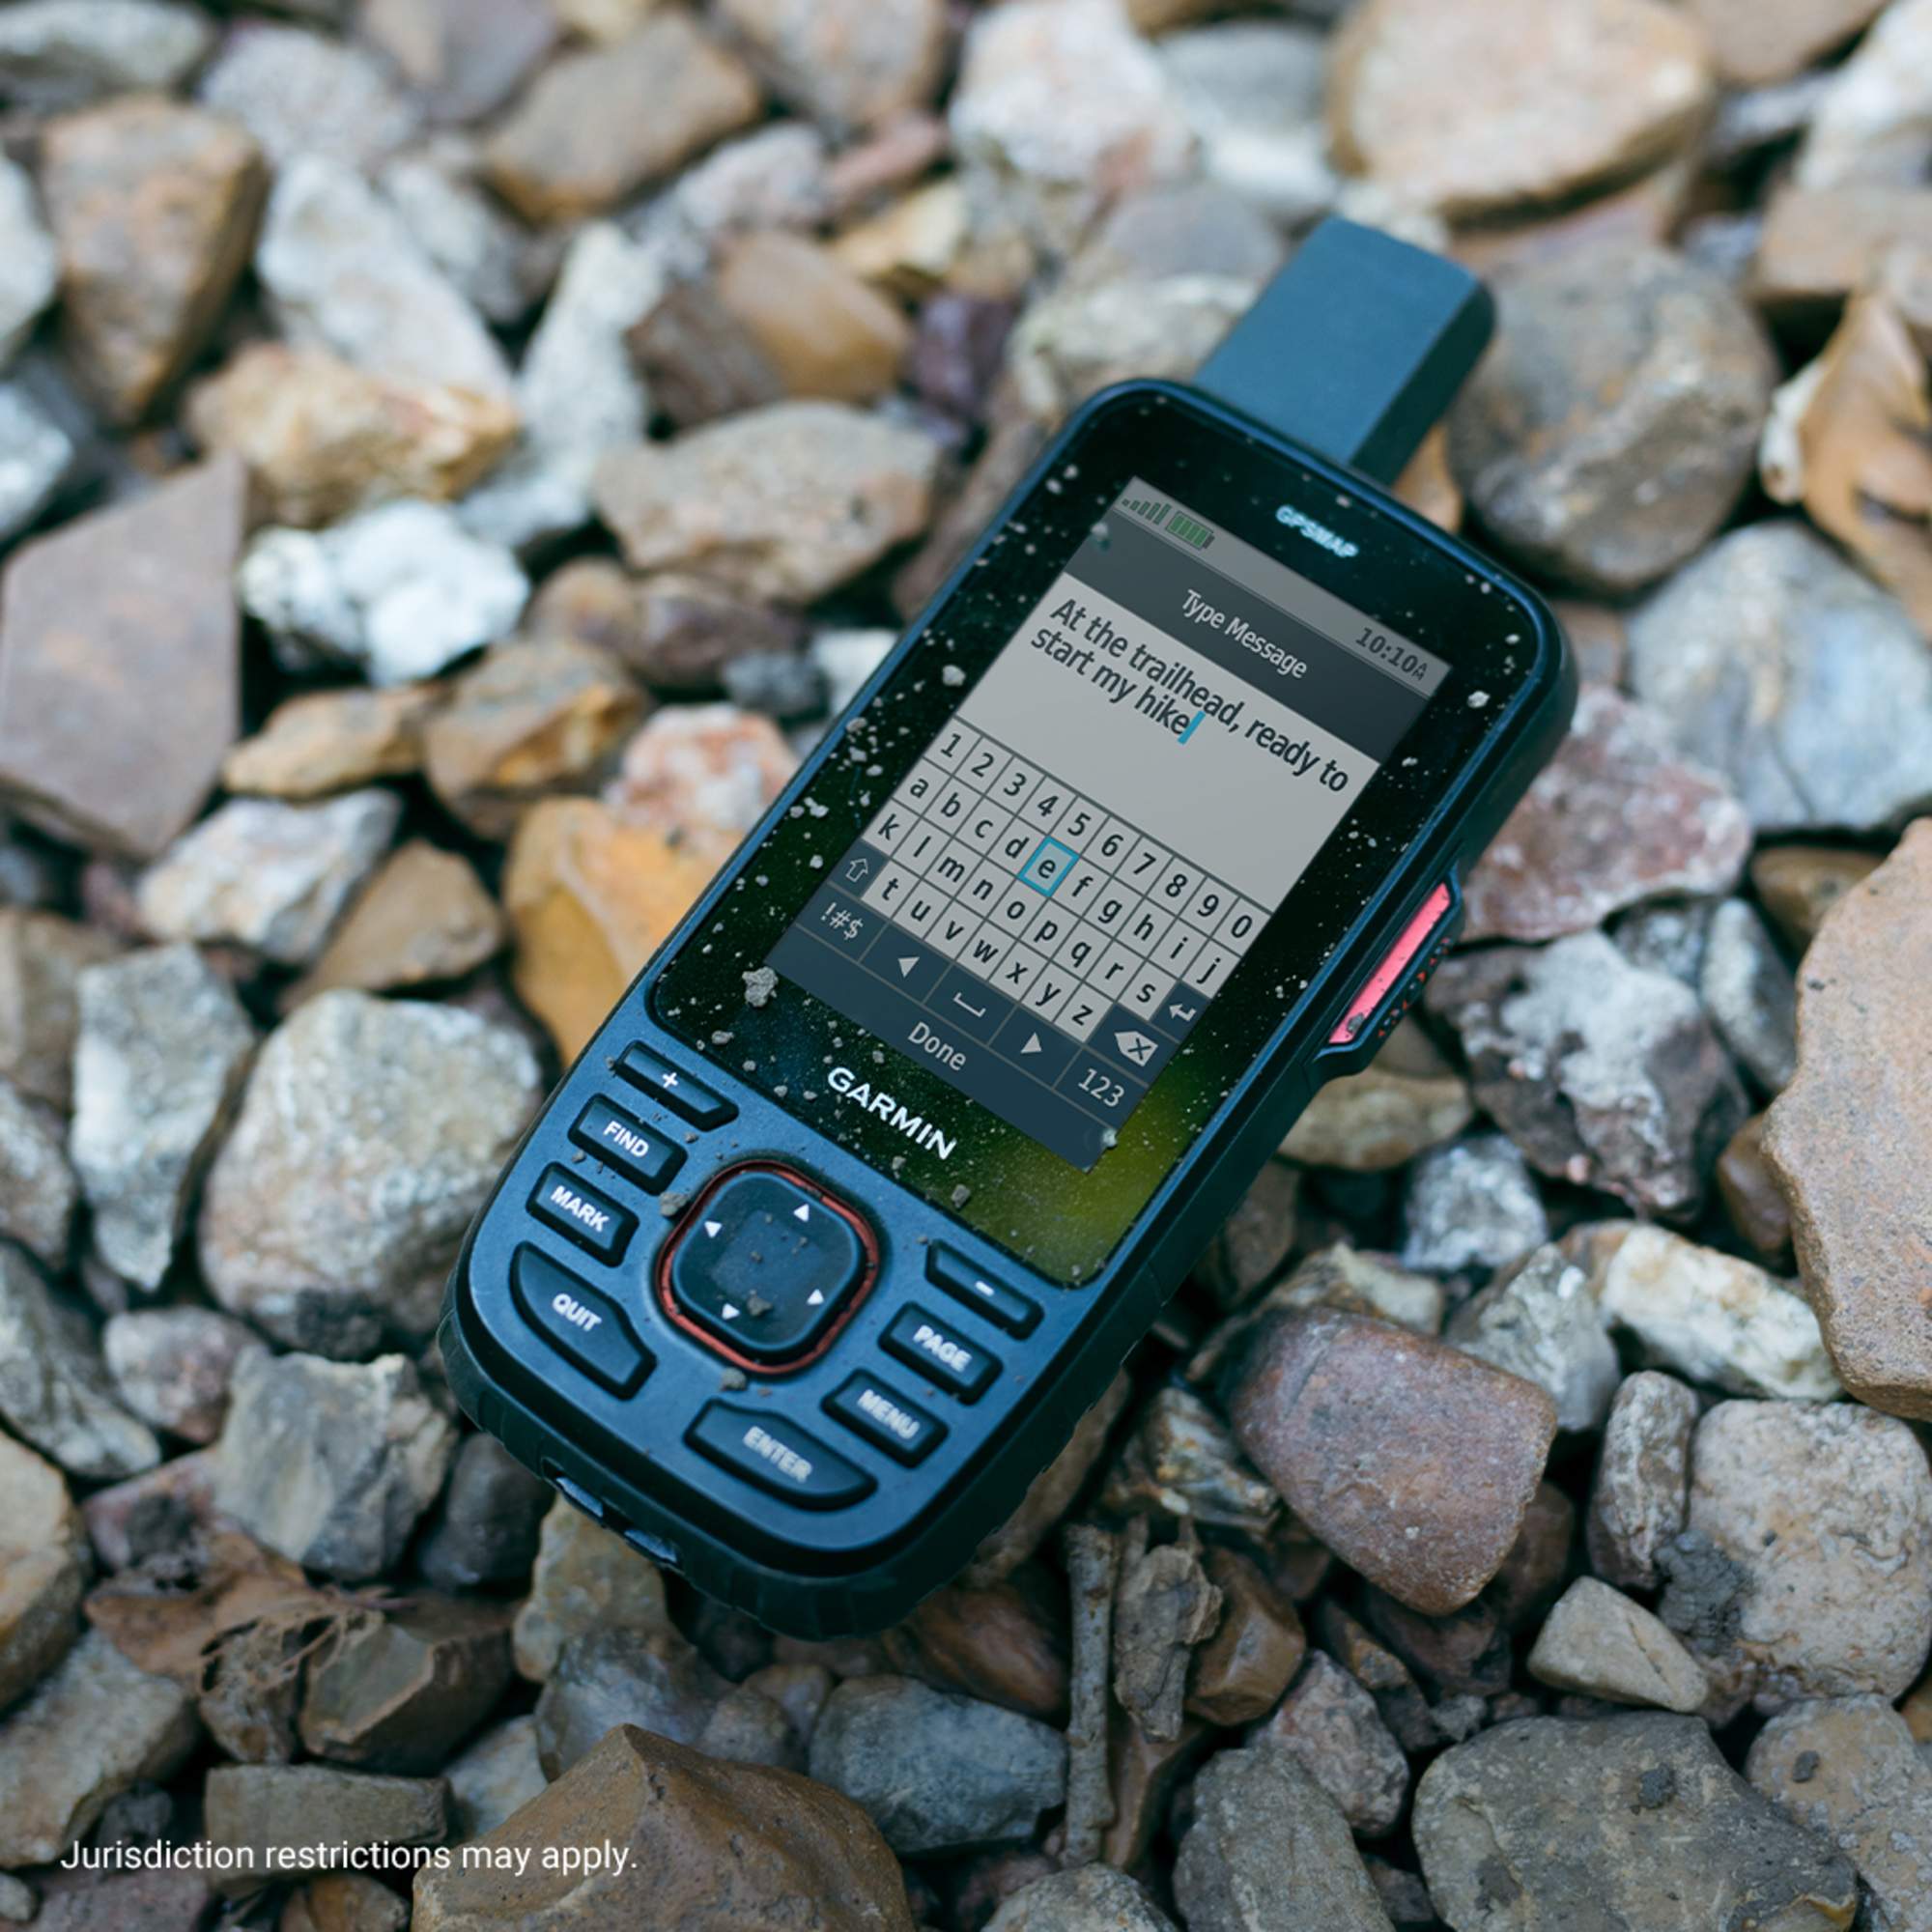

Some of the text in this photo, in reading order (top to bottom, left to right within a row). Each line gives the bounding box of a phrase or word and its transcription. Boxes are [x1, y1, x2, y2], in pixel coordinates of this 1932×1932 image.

[1276, 504, 1358, 557] GPSMAP
[1182, 589, 1307, 679] Type Message
[1030, 627, 1189, 735] start my hike
[1051, 599, 1349, 792] At the trailhead, ready to
[940, 734, 961, 758] 1
[971, 753, 996, 778] 2
[1003, 773, 1026, 797] 3
[1037, 795, 1059, 818] 4
[1067, 813, 1092, 838] 5
[1101, 834, 1123, 858] 6
[1132, 853, 1157, 875] 7
[1165, 873, 1188, 897] 8
[1198, 895, 1219, 918] 9
[878, 813, 899, 839] k
[938, 856, 966, 883] m
[974, 878, 993, 900] n
[1007, 900, 1025, 919] o
[1035, 920, 1059, 944] p
[1070, 940, 1091, 967] q
[1105, 961, 1123, 980] r
[1137, 982, 1156, 1004] s
[910, 777, 1221, 984] a b c d e f g h i j
[881, 878, 1093, 1026] t u v w x y z
[908, 1022, 966, 1071] Done
[827, 1066, 957, 1160] GARMIN
[1077, 1068, 1125, 1108] 123
[604, 1121, 649, 1157] FIND
[551, 1186, 610, 1232] MARK
[552, 1293, 602, 1331] QUIT
[913, 1325, 972, 1372] PAGE
[858, 1389, 919, 1440] MENU
[743, 1426, 813, 1482] ENTER
